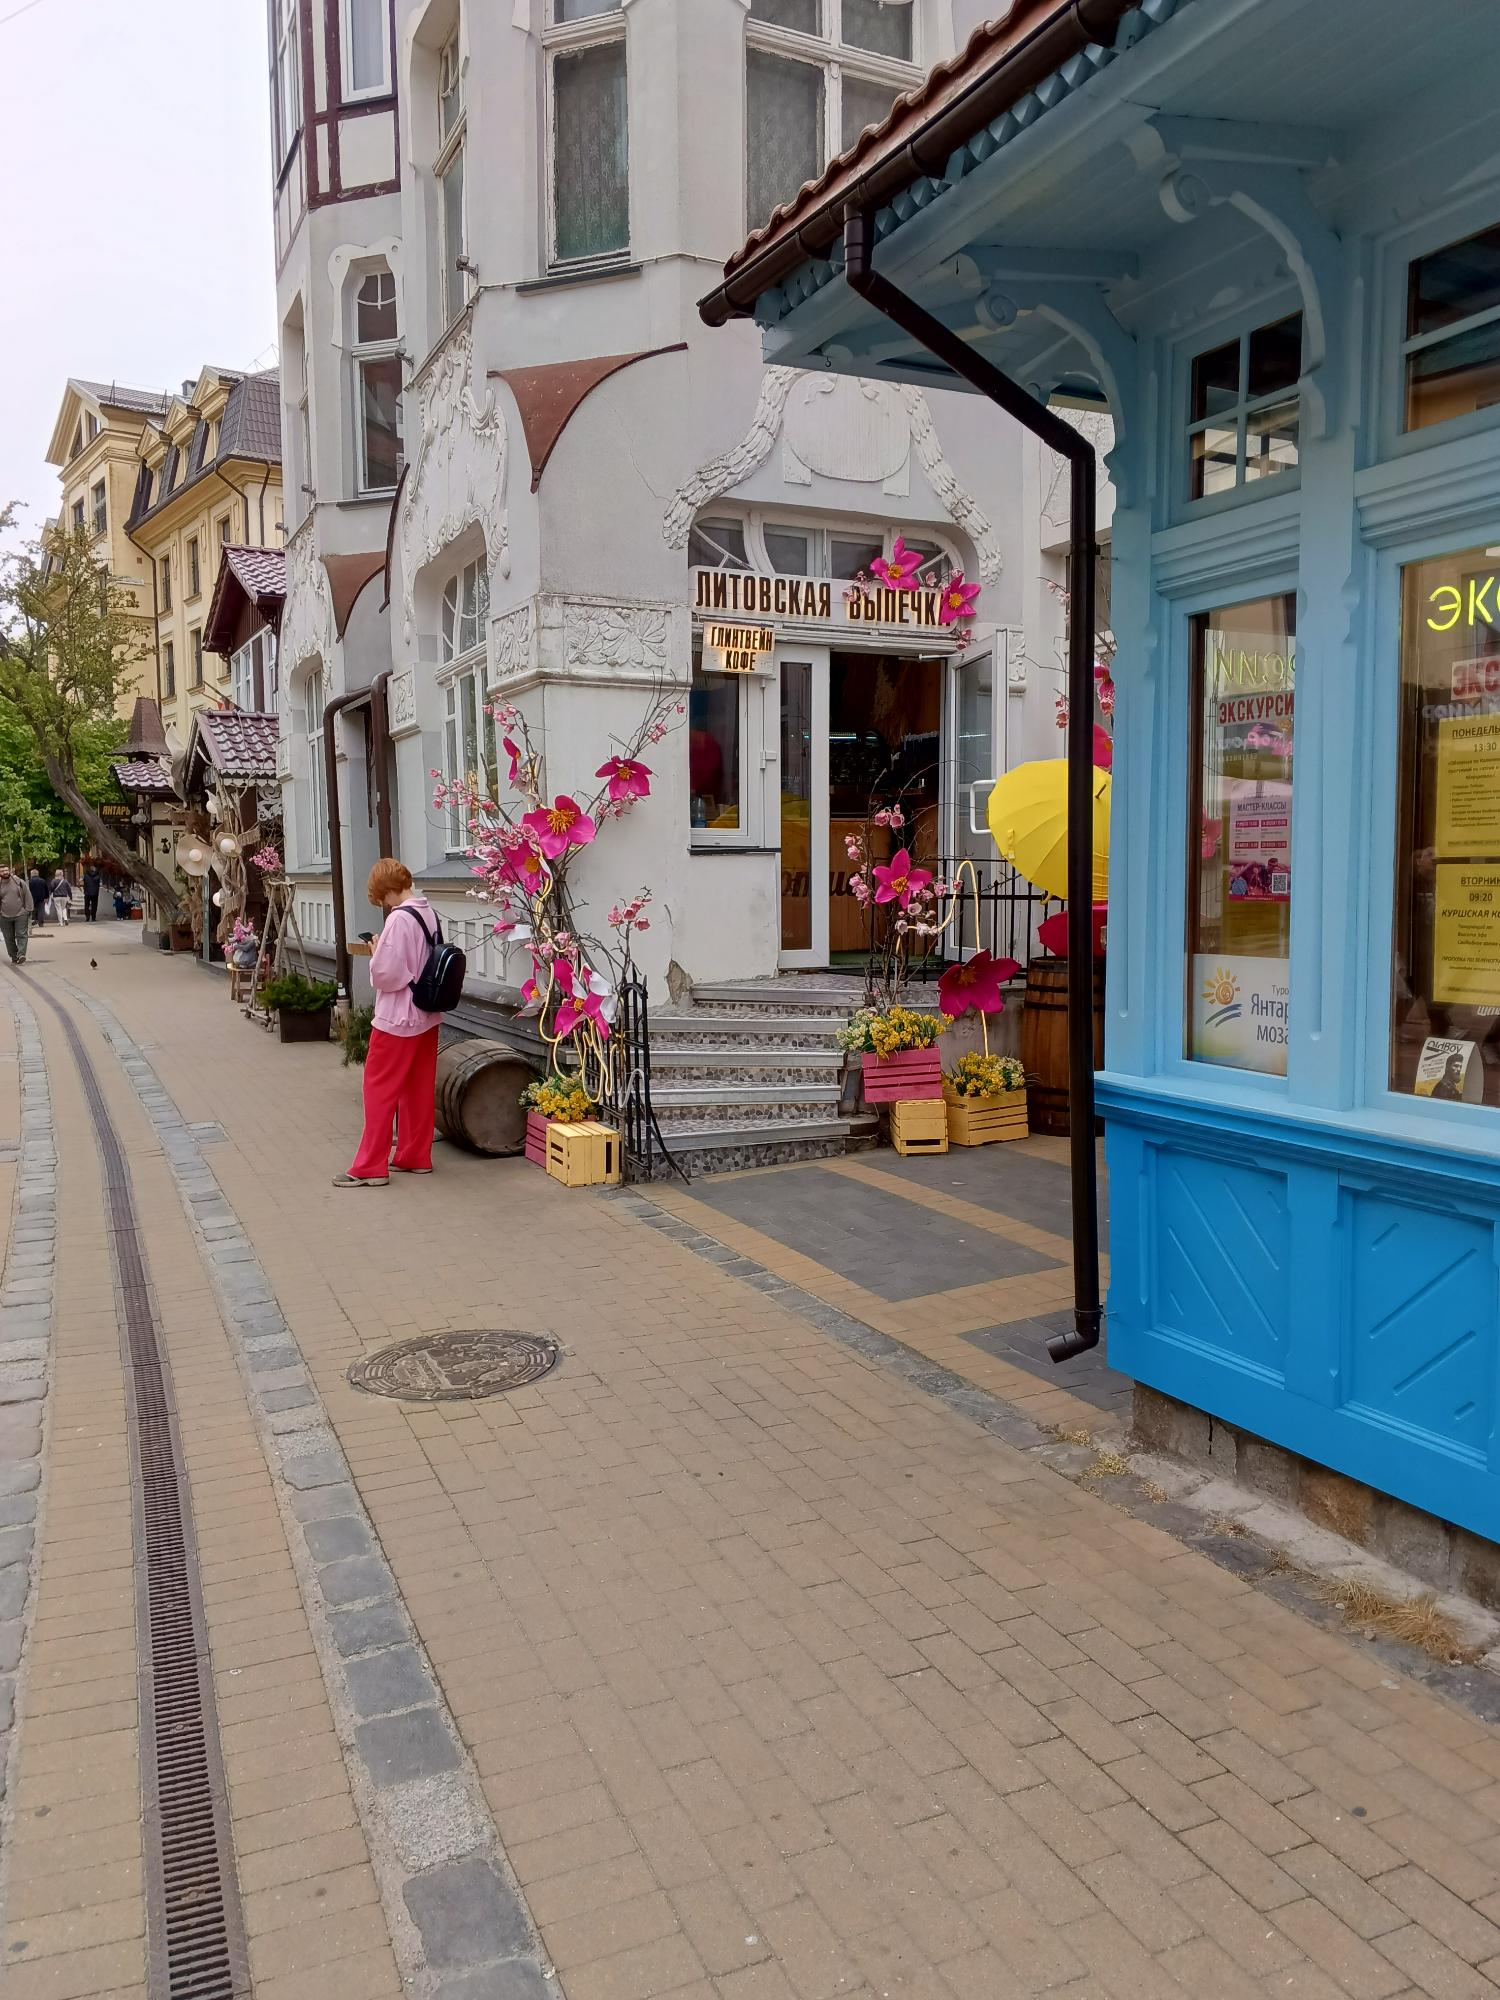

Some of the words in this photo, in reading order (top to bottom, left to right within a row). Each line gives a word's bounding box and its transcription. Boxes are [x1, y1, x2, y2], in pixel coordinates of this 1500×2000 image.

[695, 571, 831, 618] ЛИТОВСКАЯ
[1426, 576, 1500, 631] ЭК
[710, 626, 773, 651] ГЛИНТВЕЙН
[725, 650, 757, 671] КОФЕ
[1219, 693, 1295, 724] ЭКСКУРСИ
[1473, 742, 1497, 752] 13:30
[102, 805, 131, 816] ЯНТАРЬ
[1237, 801, 1287, 811] МАСТЕР-КЛАССЫ
[1441, 909, 1490, 918] КУРШСКАЯ
